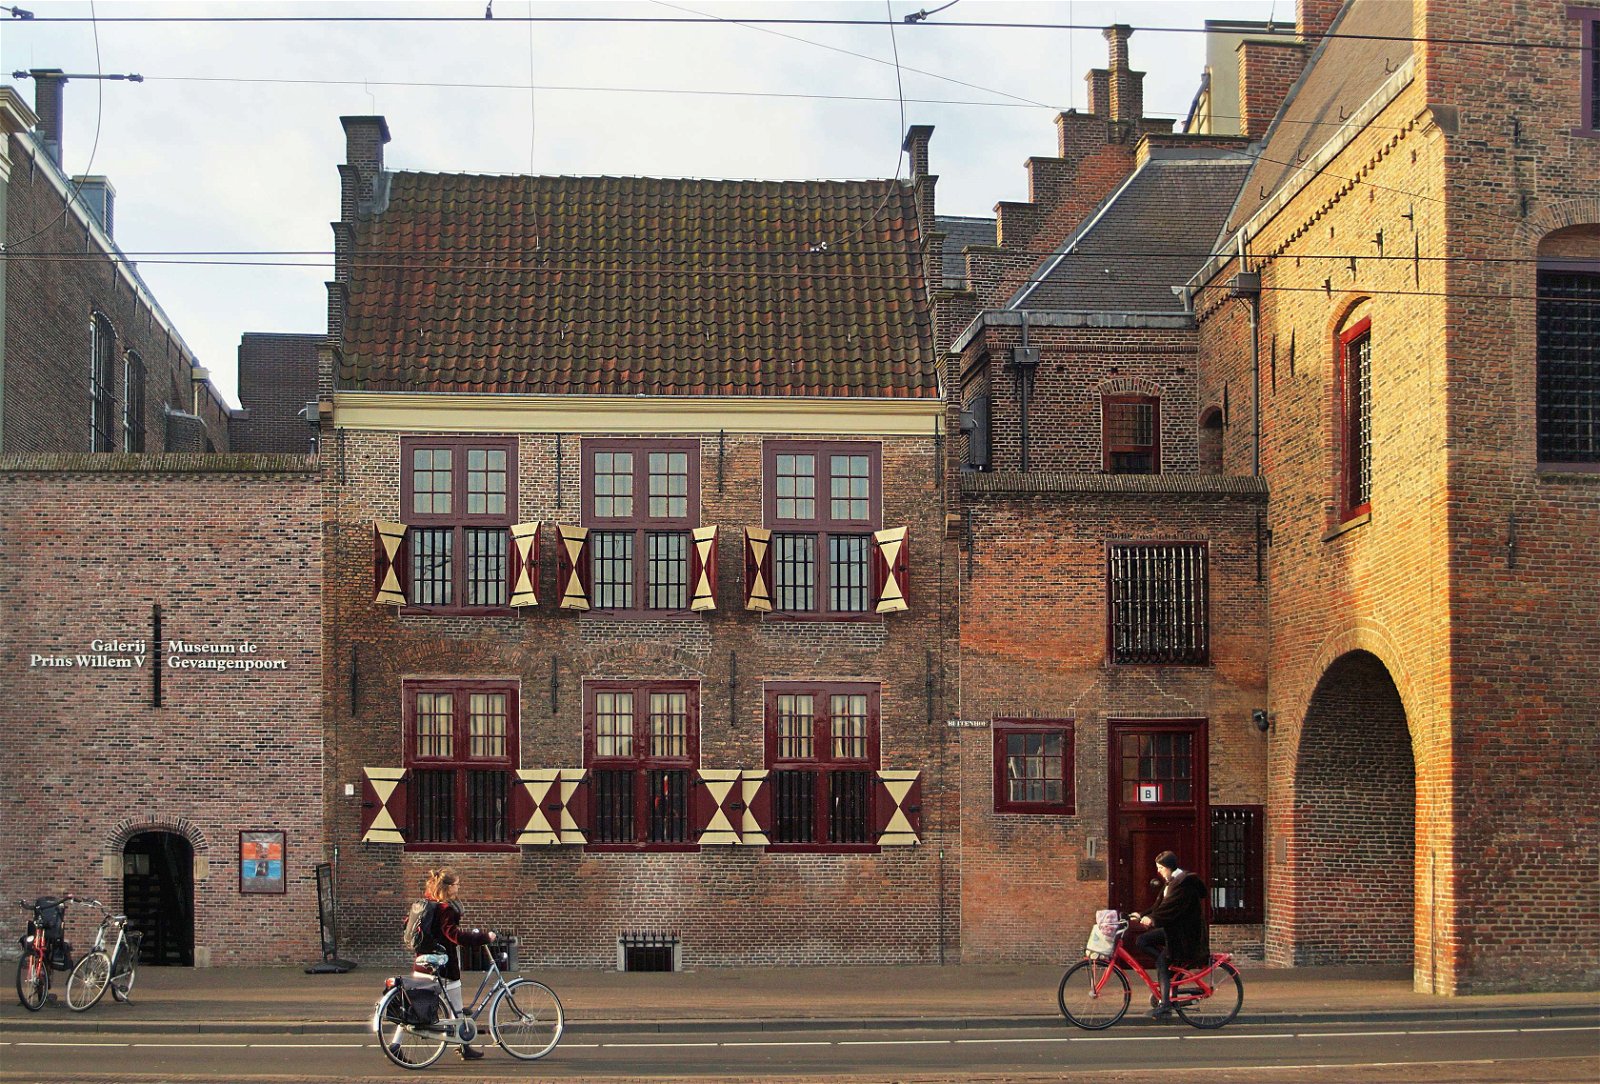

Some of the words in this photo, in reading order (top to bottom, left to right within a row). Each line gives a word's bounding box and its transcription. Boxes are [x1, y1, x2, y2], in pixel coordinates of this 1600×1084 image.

[91, 639, 146, 654] Galerij
[168, 640, 235, 653] Museum
[239, 641, 257, 653] de
[30, 654, 72, 667] Prins
[76, 655, 132, 668] Willem
[134, 655, 146, 667] V
[167, 655, 287, 672] Gevangenpoort
[1145, 790, 1151, 798] B
